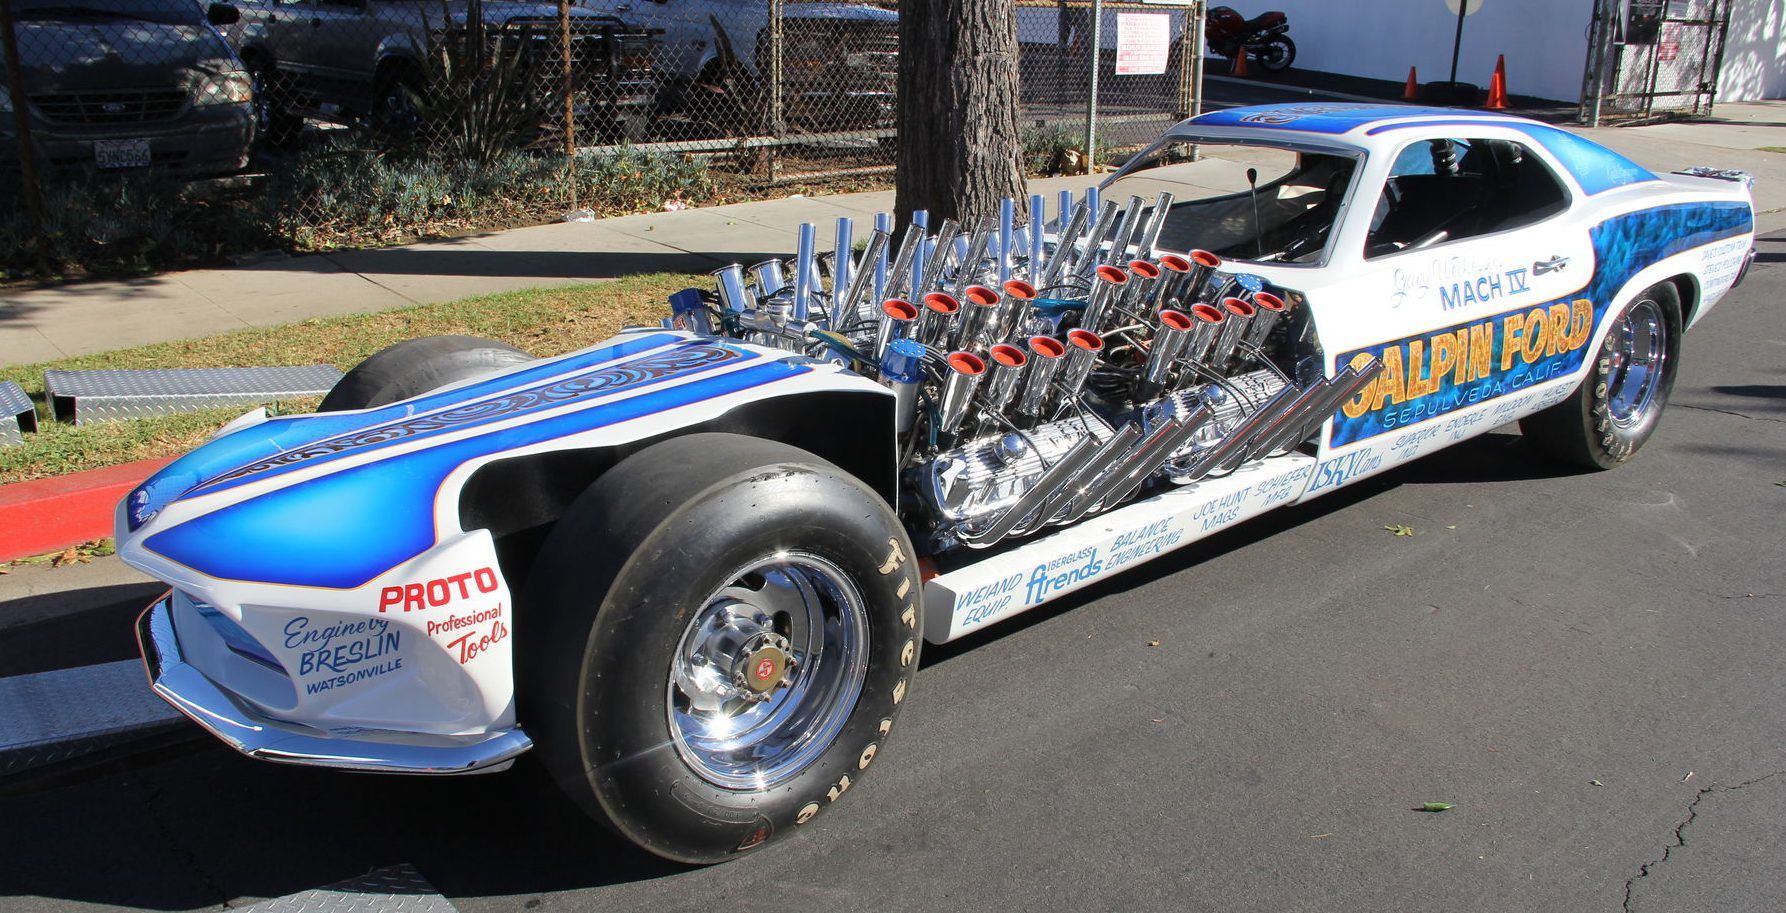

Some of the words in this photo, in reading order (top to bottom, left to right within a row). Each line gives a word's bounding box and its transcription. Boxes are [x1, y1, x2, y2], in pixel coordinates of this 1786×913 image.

[1440, 273, 1503, 311] MACH
[1505, 268, 1531, 295] IV
[1501, 298, 1594, 371] FORD
[1383, 382, 1505, 429] SEPULVEDA,
[1254, 464, 1312, 497] SCHIEFER
[1307, 452, 1362, 492] ISKY
[1193, 499, 1220, 520] JOE
[1218, 486, 1252, 510] HUNT
[1200, 506, 1240, 533] MAGS
[1104, 528, 1185, 571] ENGINEERING
[1110, 516, 1174, 552] BALANCE
[379, 567, 498, 613] PROTO
[957, 573, 1023, 611] WEIAND
[284, 616, 366, 653] Engine
[427, 602, 502, 637] Professional
[300, 630, 400, 676] BRESLIN
[447, 621, 508, 665] Tools
[307, 658, 403, 695] WATSONVILLE
